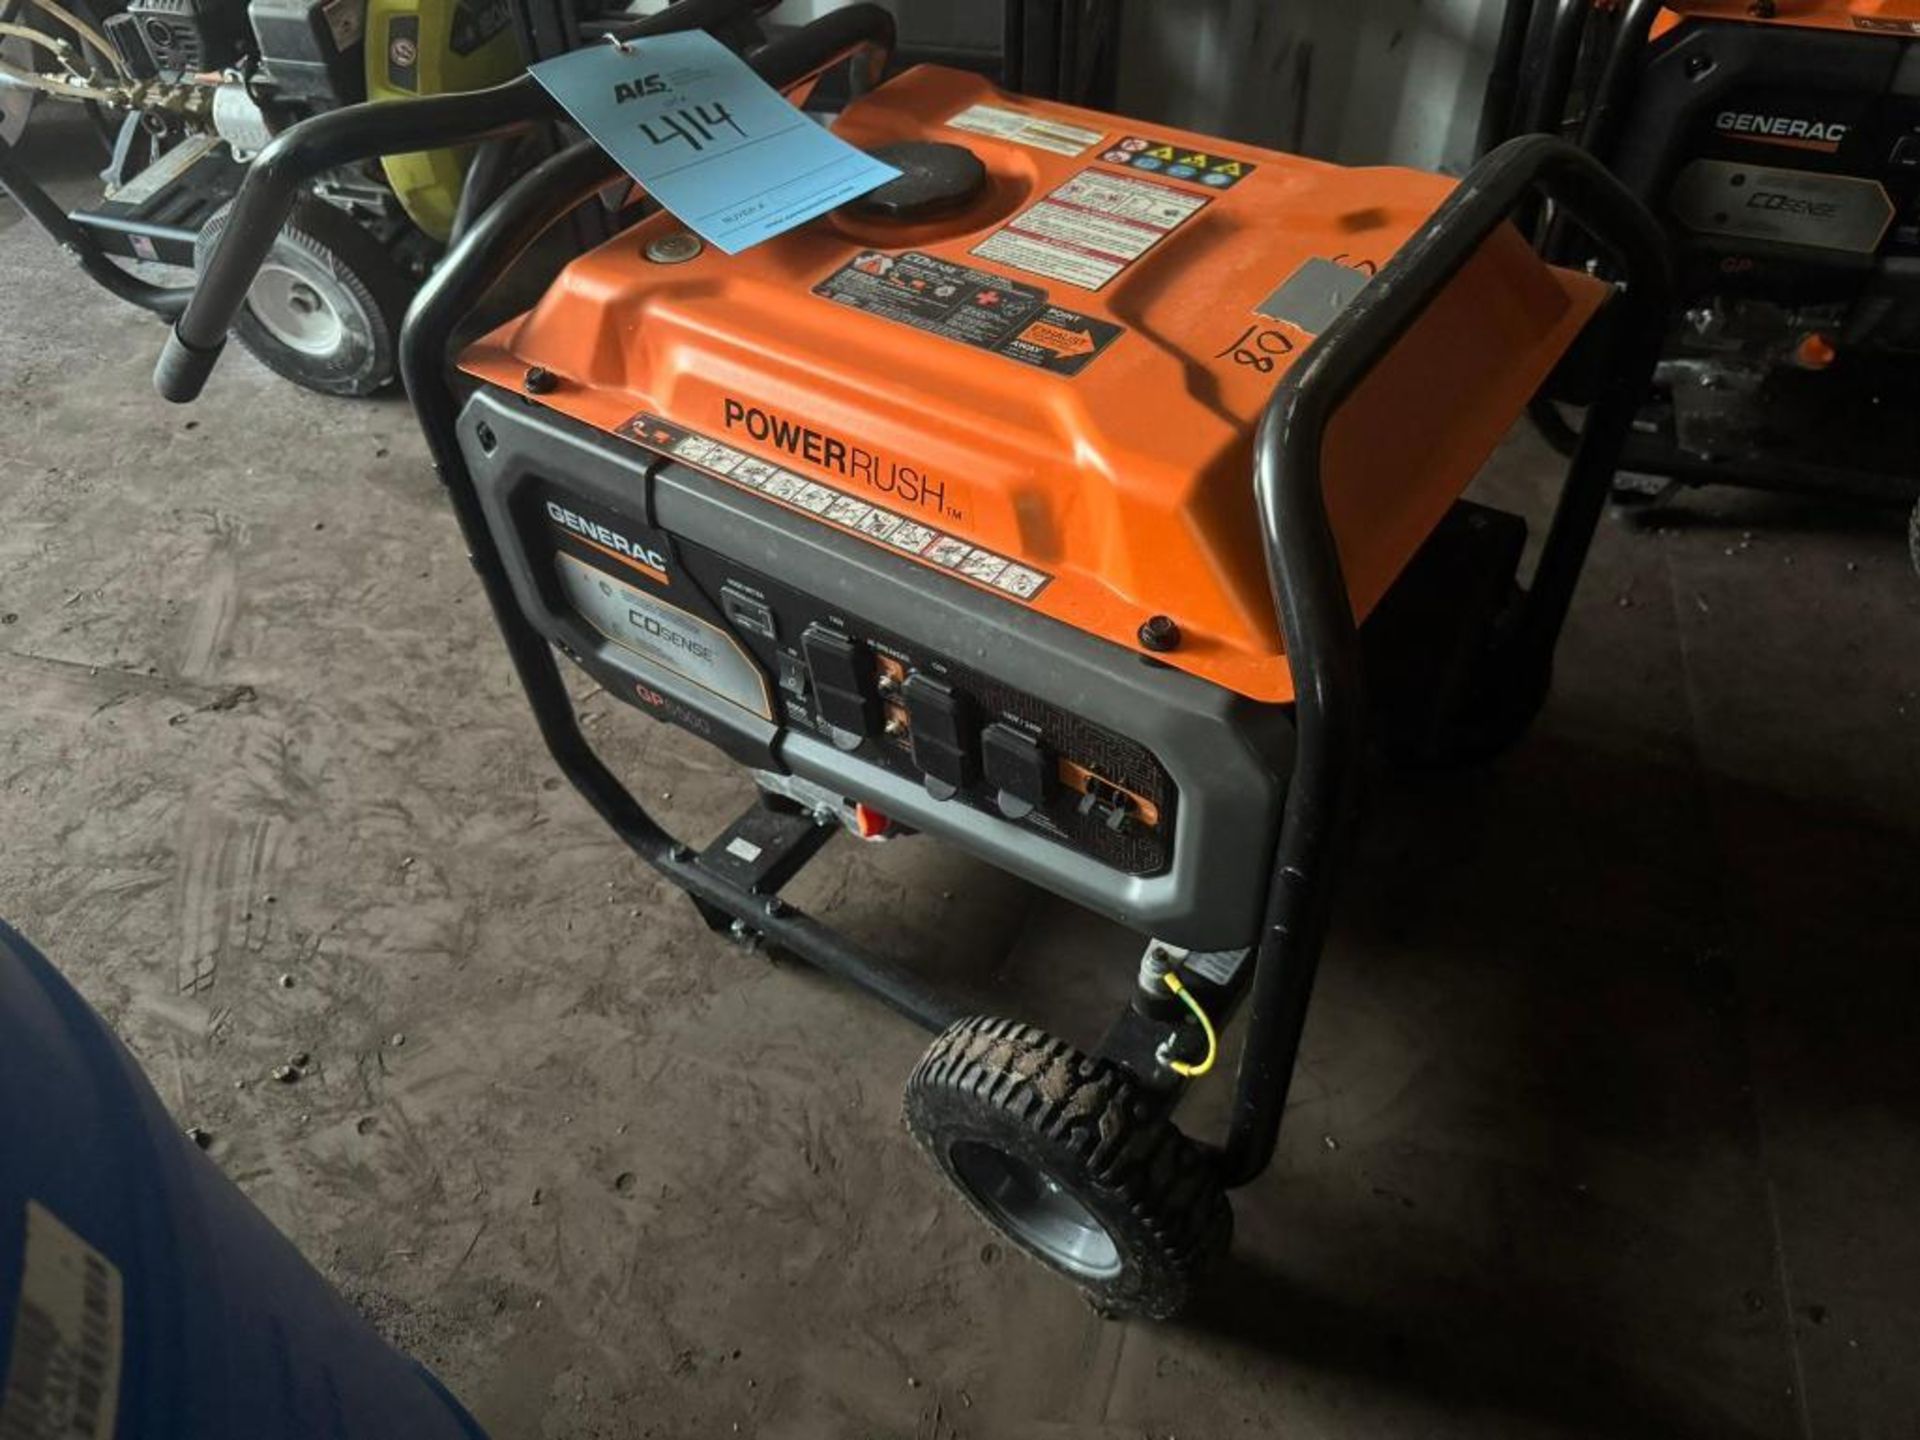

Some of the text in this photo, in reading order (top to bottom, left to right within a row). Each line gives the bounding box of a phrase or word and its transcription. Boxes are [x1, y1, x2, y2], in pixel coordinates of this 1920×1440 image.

[638, 102, 748, 150] 414
[1714, 111, 1847, 141] GENERAC
[724, 398, 945, 513] POWERRUSH
[546, 500, 667, 572] GENERAC
[628, 608, 714, 662] COSENSE
